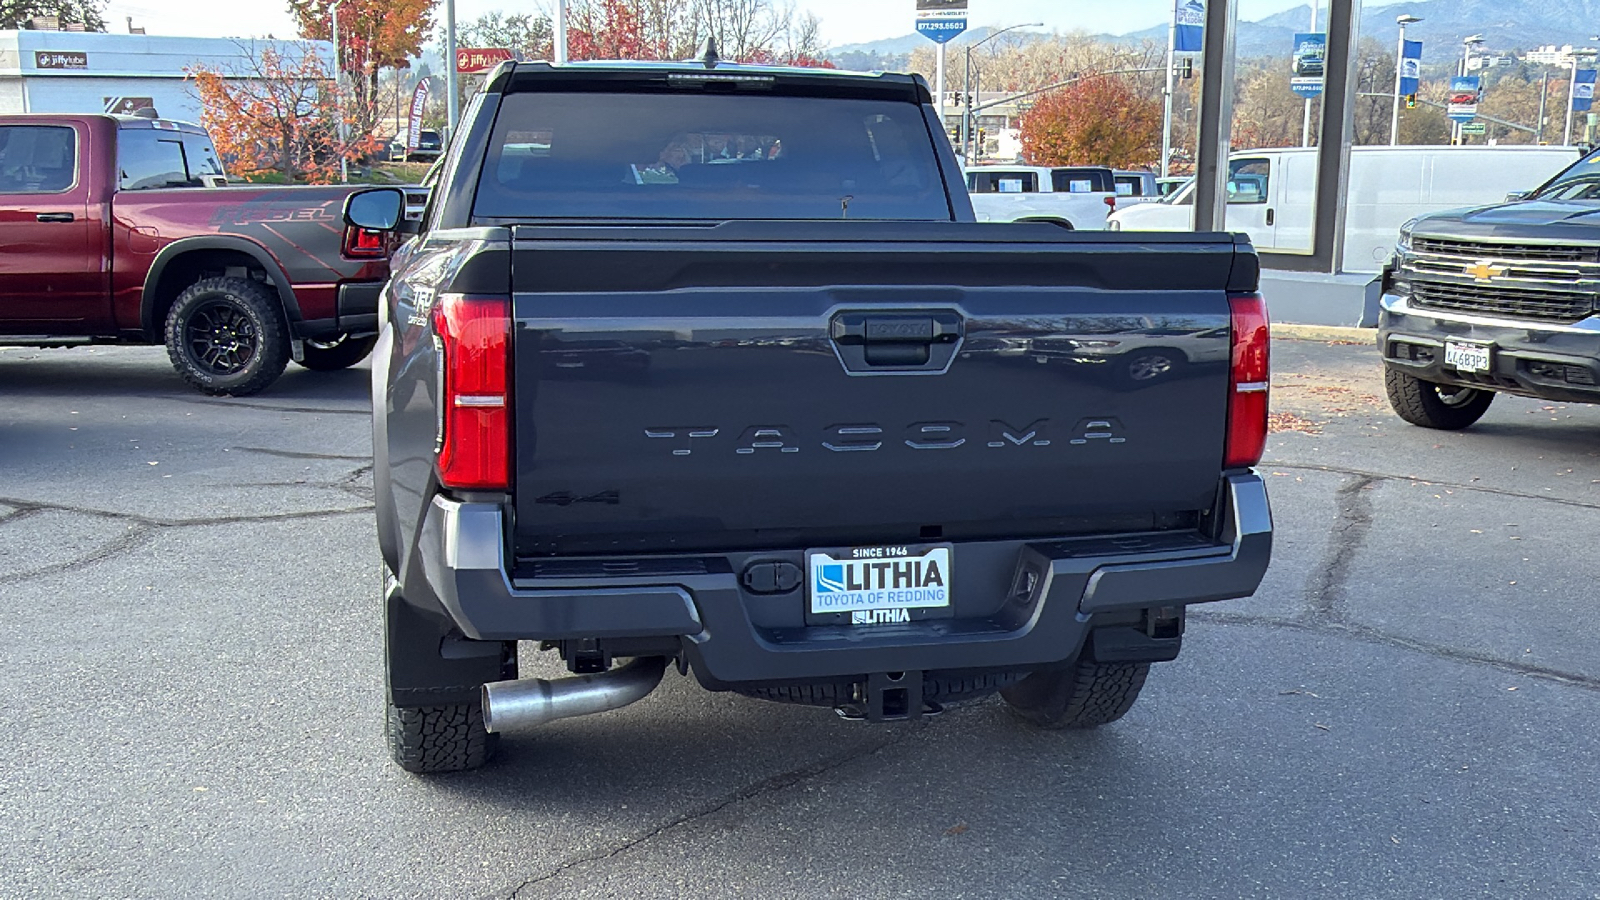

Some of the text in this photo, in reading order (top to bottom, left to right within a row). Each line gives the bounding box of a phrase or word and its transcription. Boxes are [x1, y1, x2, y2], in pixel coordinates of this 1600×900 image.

[869, 322, 930, 336] TOYOTA
[644, 416, 1127, 455] TACOMA
[852, 546, 908, 558] SINCE 1946
[846, 560, 944, 591] LITHIA
[816, 589, 945, 607] TOYOTA OF REDDING
[866, 608, 911, 623] LITHIA
